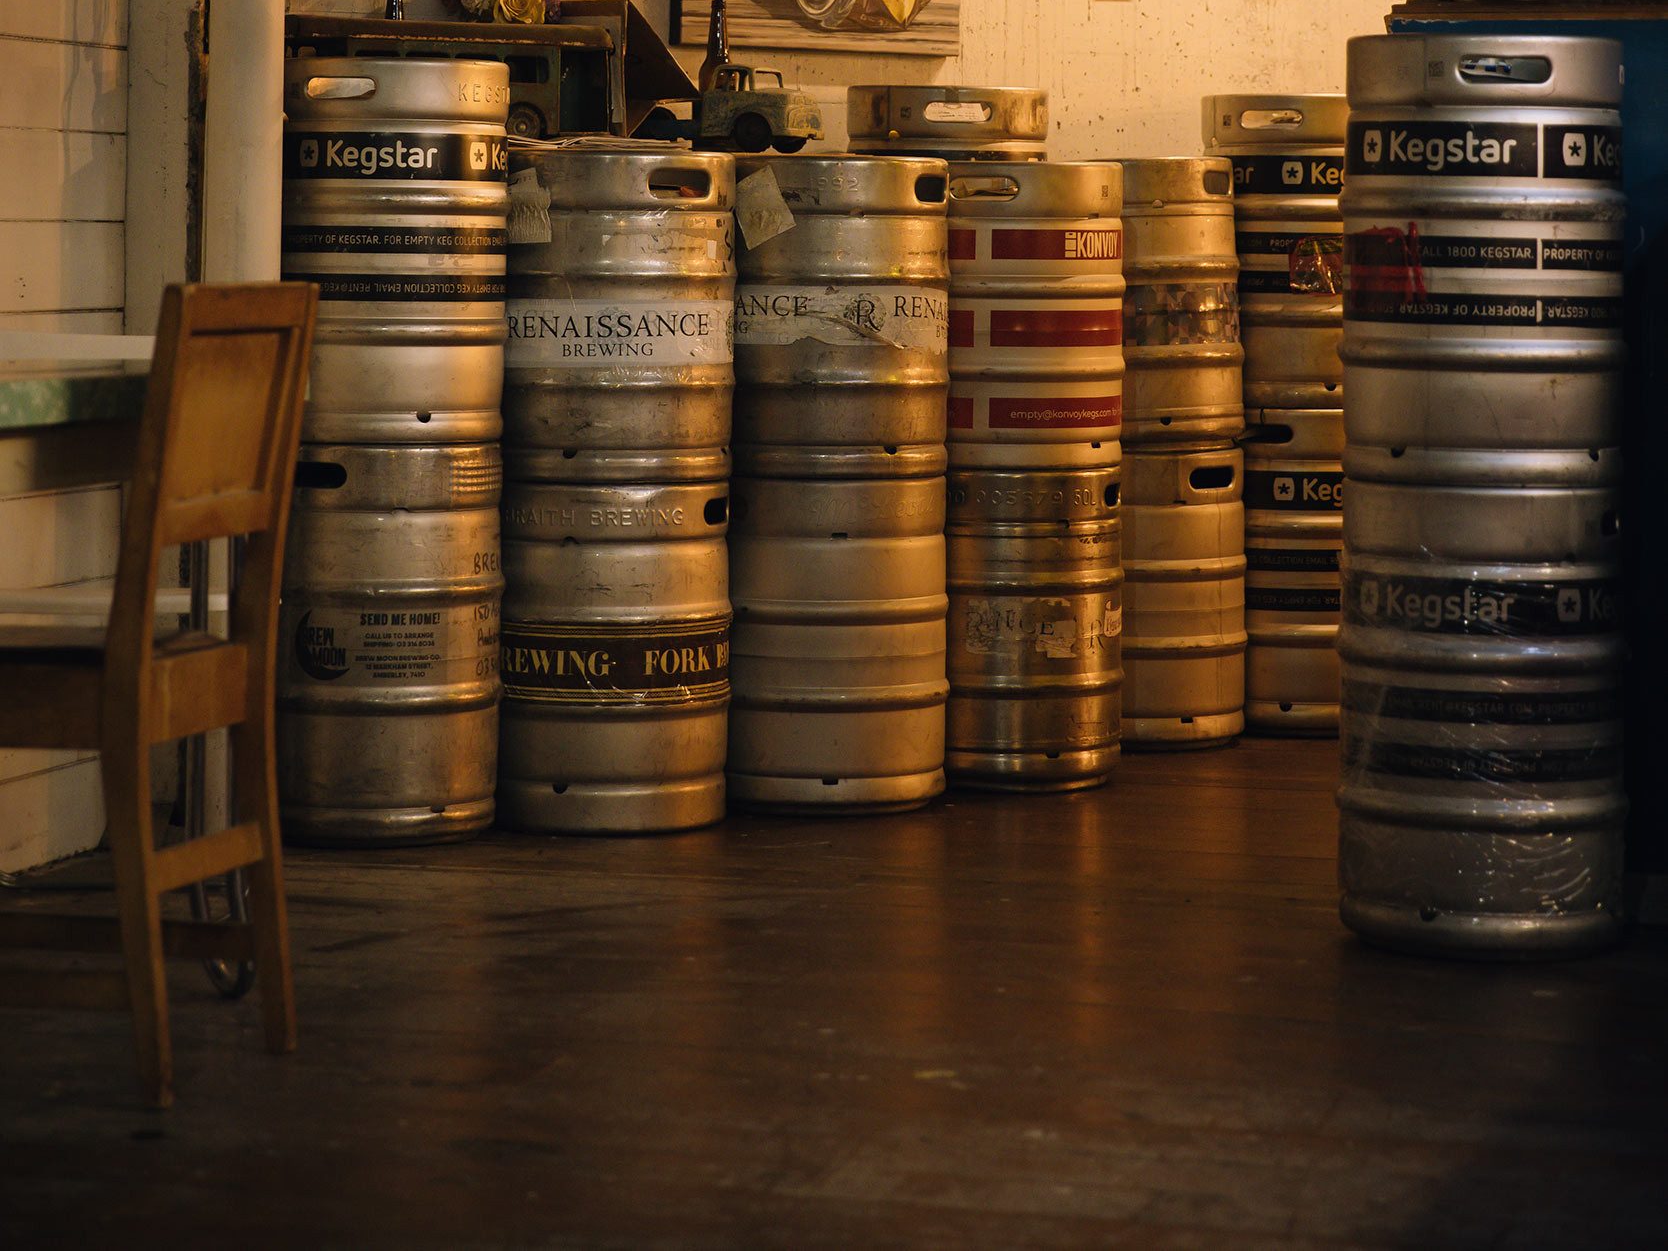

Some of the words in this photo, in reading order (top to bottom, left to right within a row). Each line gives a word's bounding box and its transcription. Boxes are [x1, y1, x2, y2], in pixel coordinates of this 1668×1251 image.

[326, 139, 438, 176] Kegstar
[491, 142, 508, 172] Ke
[1390, 129, 1517, 172] Kegstar
[1310, 161, 1345, 187] Ke
[325, 234, 337, 244] OF
[338, 234, 381, 245] KEGSTAR.
[384, 235, 401, 245] FOR
[404, 235, 435, 246] EMPTY
[437, 236, 453, 246] KEG
[455, 236, 491, 247] COLLECTION
[1076, 231, 1119, 258] KONVOY
[1418, 246, 1442, 257] ALL
[1447, 245, 1476, 258] 1800
[1480, 246, 1534, 260] KEGSTAR.
[1543, 247, 1593, 261] PROPERTY
[374, 282, 401, 293] EMAIL
[404, 283, 455, 293] COLLECTION
[456, 283, 471, 293] KEG
[1453, 304, 1467, 315] OF
[1471, 304, 1536, 317] PROPERTY
[508, 313, 709, 339] RENAISSANCE
[562, 343, 654, 358] BREWING
[1010, 408, 1111, 421] empty@konvoykegs.com
[590, 508, 683, 526] BREWING
[1386, 584, 1516, 628] Kegstar
[360, 613, 388, 626] SEND
[391, 613, 406, 626] ME
[409, 612, 441, 625] HOME!
[643, 645, 711, 676] FORK
